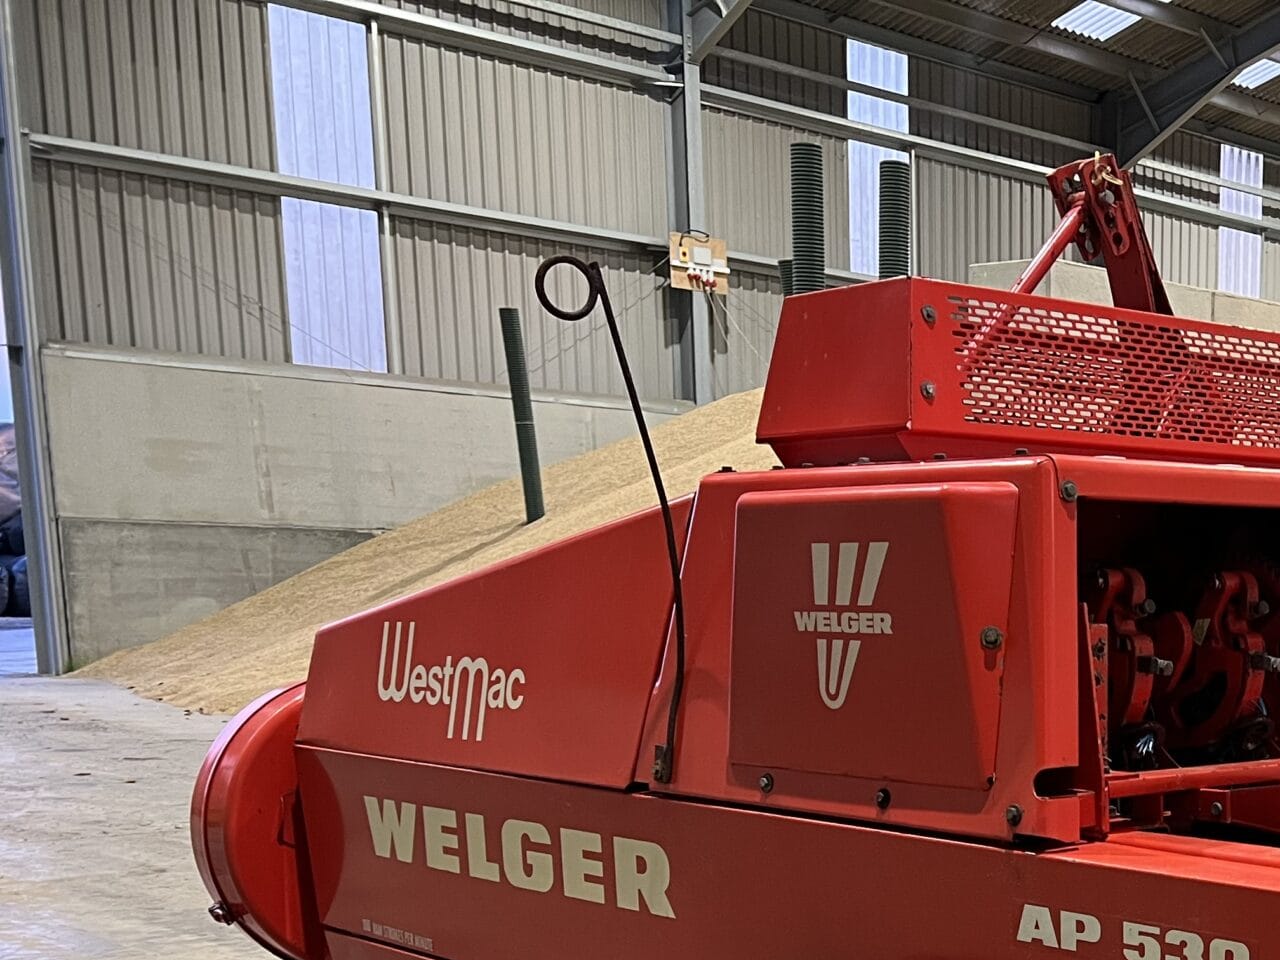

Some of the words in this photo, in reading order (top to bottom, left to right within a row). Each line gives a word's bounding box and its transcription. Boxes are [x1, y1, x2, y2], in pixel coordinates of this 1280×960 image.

[794, 611, 894, 635] WELGER
[363, 795, 677, 919] WELGER
[1016, 903, 1101, 952] AP
